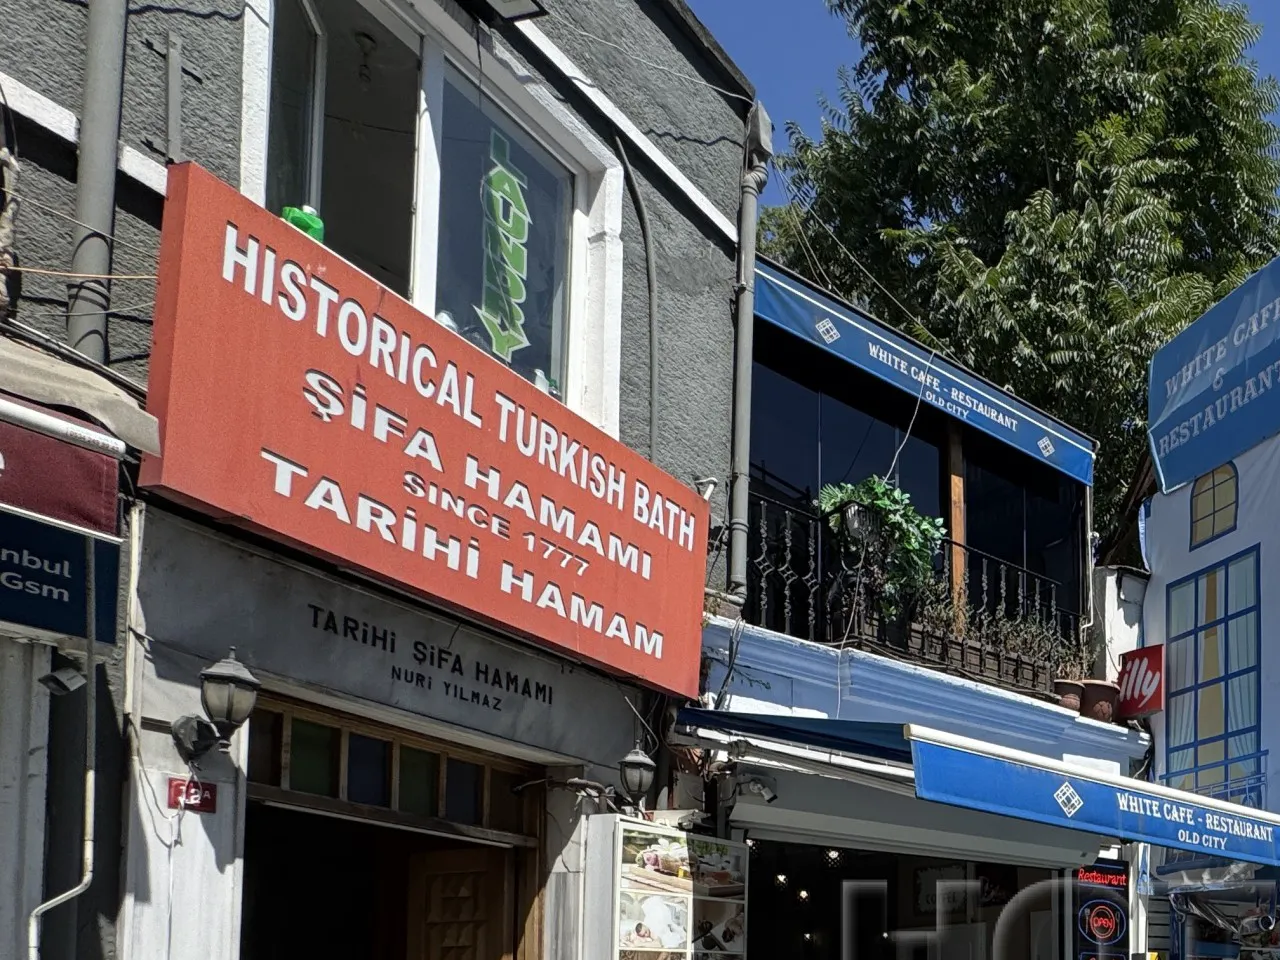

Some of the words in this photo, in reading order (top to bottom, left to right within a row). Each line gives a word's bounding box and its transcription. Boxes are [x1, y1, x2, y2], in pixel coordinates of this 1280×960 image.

[222, 222, 482, 428] HISTORICAL
[495, 391, 626, 510] TURKISH
[634, 480, 696, 552] BATH
[868, 342, 908, 380] WHITE
[910, 366, 940, 393] CAFE
[951, 387, 1018, 432] RESTAURANT
[1165, 335, 1229, 399] WHITE
[925, 390, 945, 409] OLD
[946, 401, 969, 419] CITY
[303, 368, 445, 472] ŞİFA
[464, 454, 652, 580] HAMAMI
[403, 471, 511, 540] SINCE
[523, 533, 590, 577] 1777
[0, 547, 72, 579] nbul
[261, 447, 480, 580] TARİHİ
[500, 560, 664, 659] HAMAM
[0, 571, 70, 602] Gsm
[442, 681, 503, 712] YILMAZ
[475, 661, 553, 705] HAMAMI
[1119, 656, 1161, 708] illy
[1116, 792, 1162, 819] WHITE
[1163, 803, 1195, 826] CAFE
[1205, 813, 1273, 842] RESTAURANT
[1178, 829, 1200, 845] OLD
[1202, 834, 1228, 850] CITY
[1078, 867, 1127, 886] Restaurant
[1093, 915, 1113, 929] OPEN
